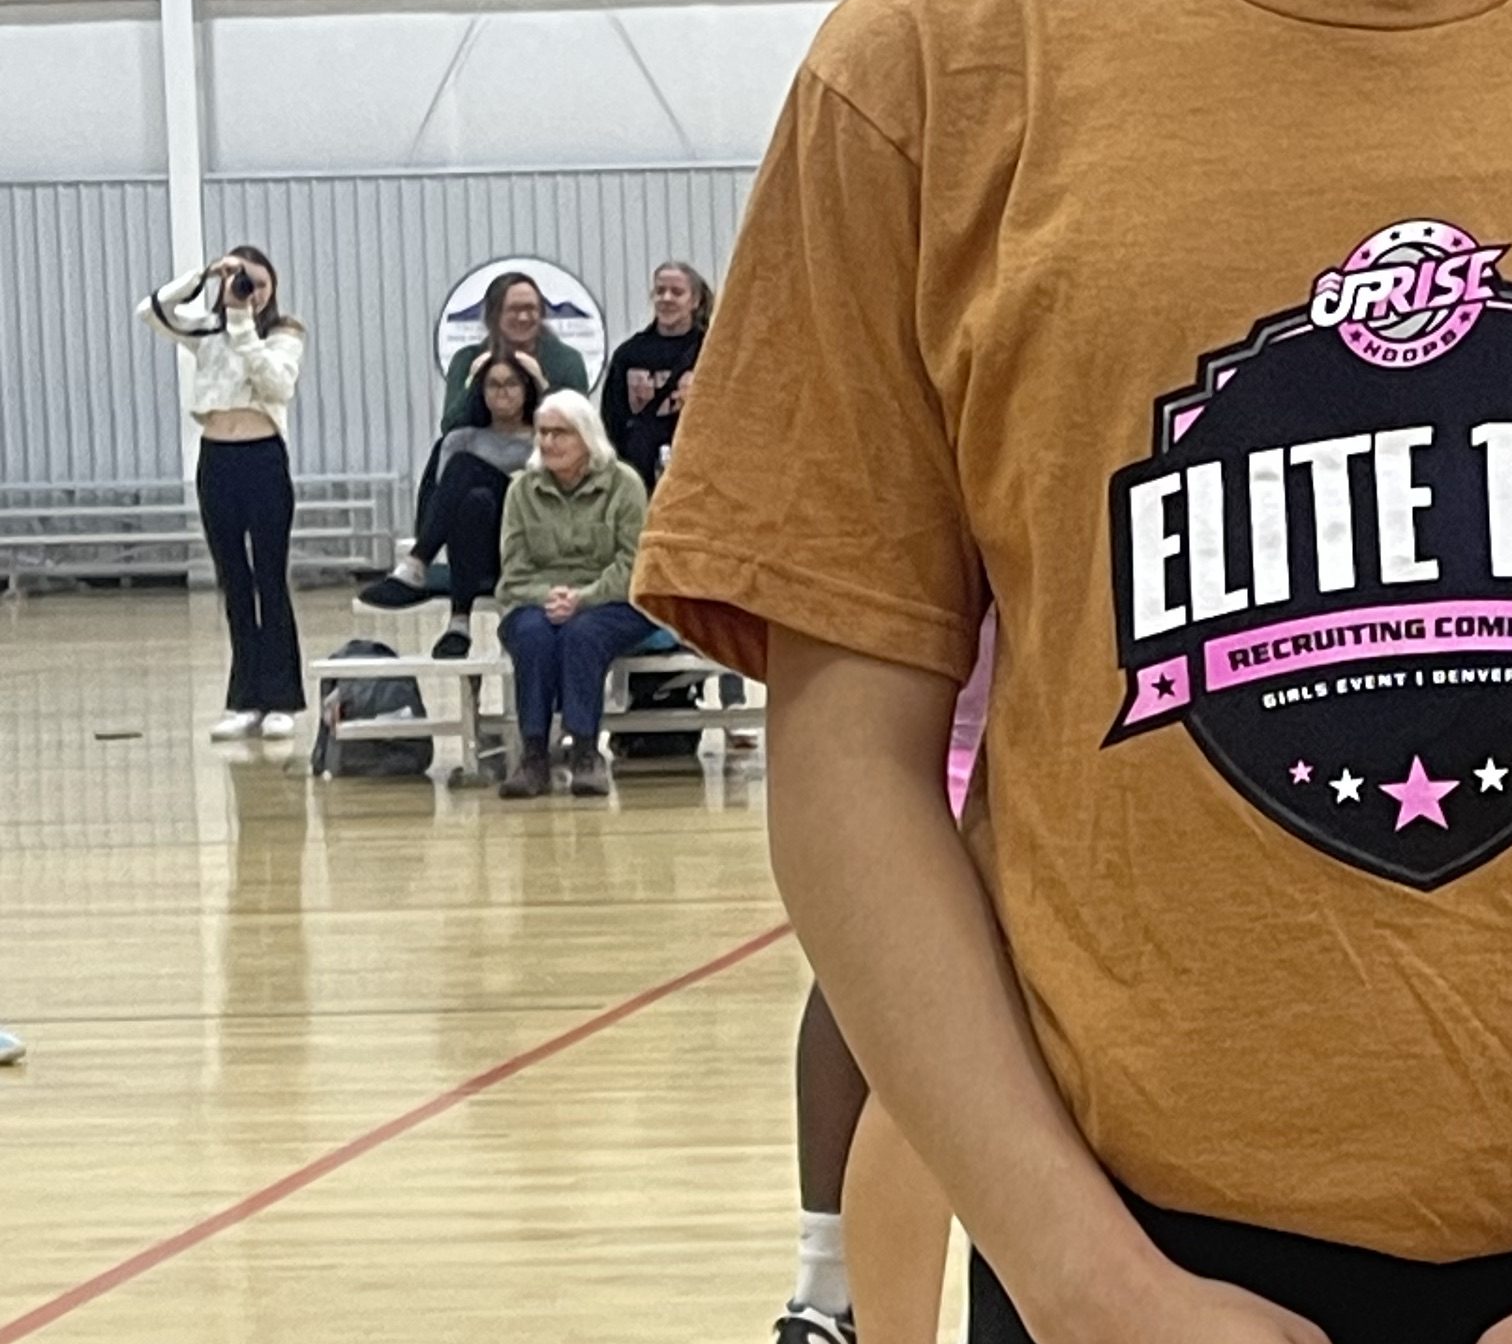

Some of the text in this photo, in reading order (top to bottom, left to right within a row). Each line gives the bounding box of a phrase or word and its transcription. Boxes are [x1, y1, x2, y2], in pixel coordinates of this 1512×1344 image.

[1310, 248, 1503, 327] UPRISE
[1362, 328, 1458, 362] HOOPS
[1129, 425, 1440, 642] ELITE
[1227, 618, 1426, 672] RECRUITING
[1261, 682, 1328, 710] GIRLS
[1336, 671, 1407, 695] EVENT
